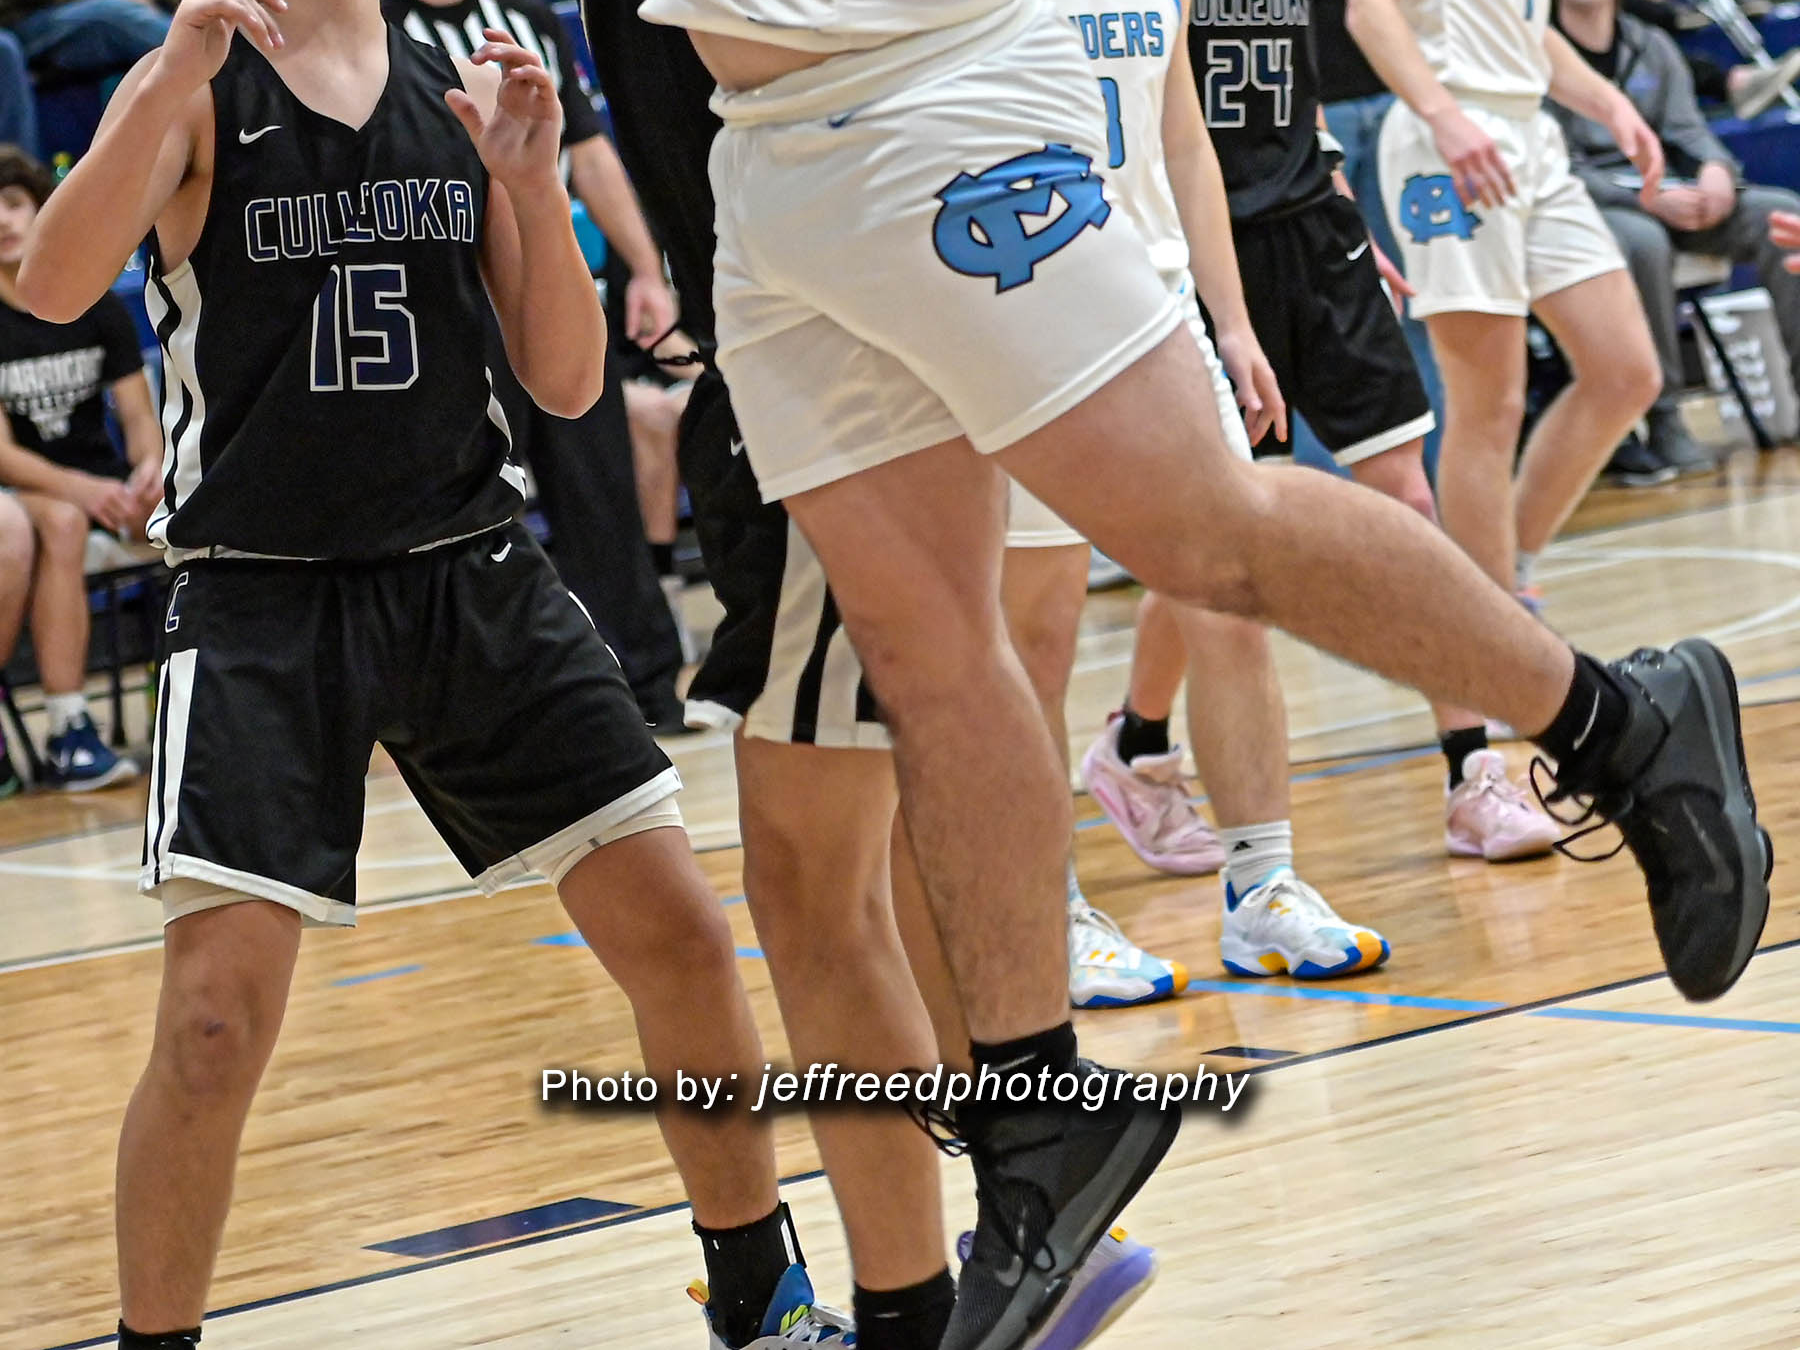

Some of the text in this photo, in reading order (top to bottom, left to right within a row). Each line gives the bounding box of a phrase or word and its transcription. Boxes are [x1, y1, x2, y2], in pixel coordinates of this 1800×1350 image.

[1068, 11, 1164, 60] DERS
[1205, 38, 1293, 128] 24
[310, 264, 419, 392] 15
